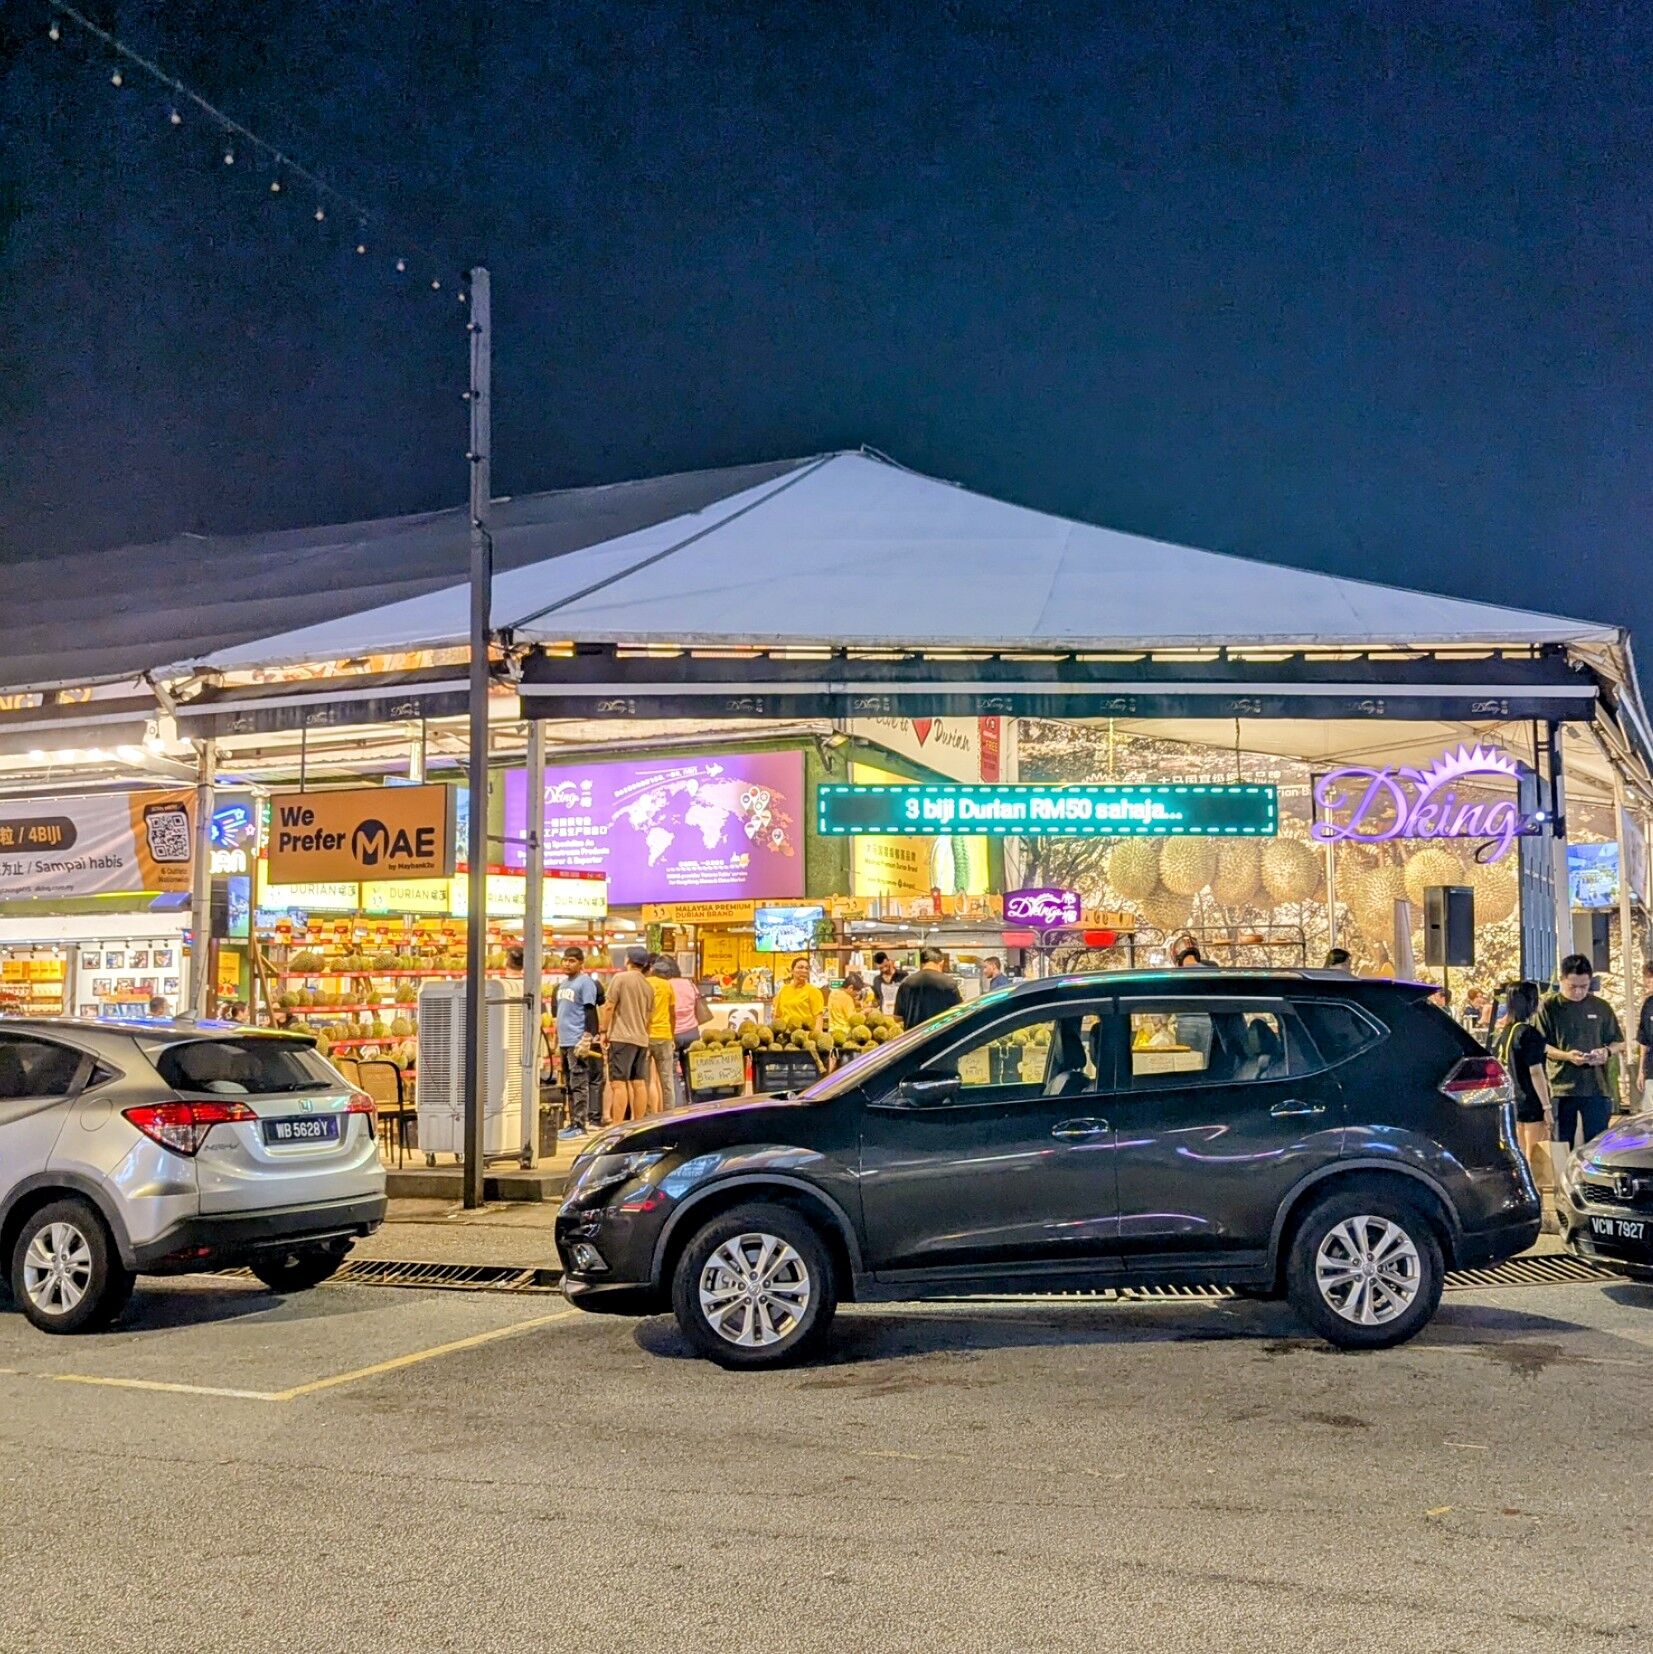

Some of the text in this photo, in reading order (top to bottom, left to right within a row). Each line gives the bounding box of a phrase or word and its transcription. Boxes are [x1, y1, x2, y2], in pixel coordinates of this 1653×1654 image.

[280, 806, 315, 827] We
[905, 798, 920, 819] 3
[923, 798, 955, 824] biji
[959, 798, 1026, 819] Durian
[1030, 798, 1092, 819] RM50
[28, 825, 62, 846] 4BIJI
[279, 819, 435, 866] Prefer MAE
[0, 860, 24, 876] 为止
[35, 858, 87, 874] Sampai
[89, 854, 123, 869] habis
[388, 863, 397, 871] by
[290, 883, 336, 896] DURIAN
[389, 887, 429, 900] DURIAN
[675, 903, 751, 912] MALAYSIA PREMIUM
[675, 910, 734, 919] DURIAN BRAND
[276, 1122, 293, 1138] WB
[1592, 1217, 1645, 1239] VCW 7927
